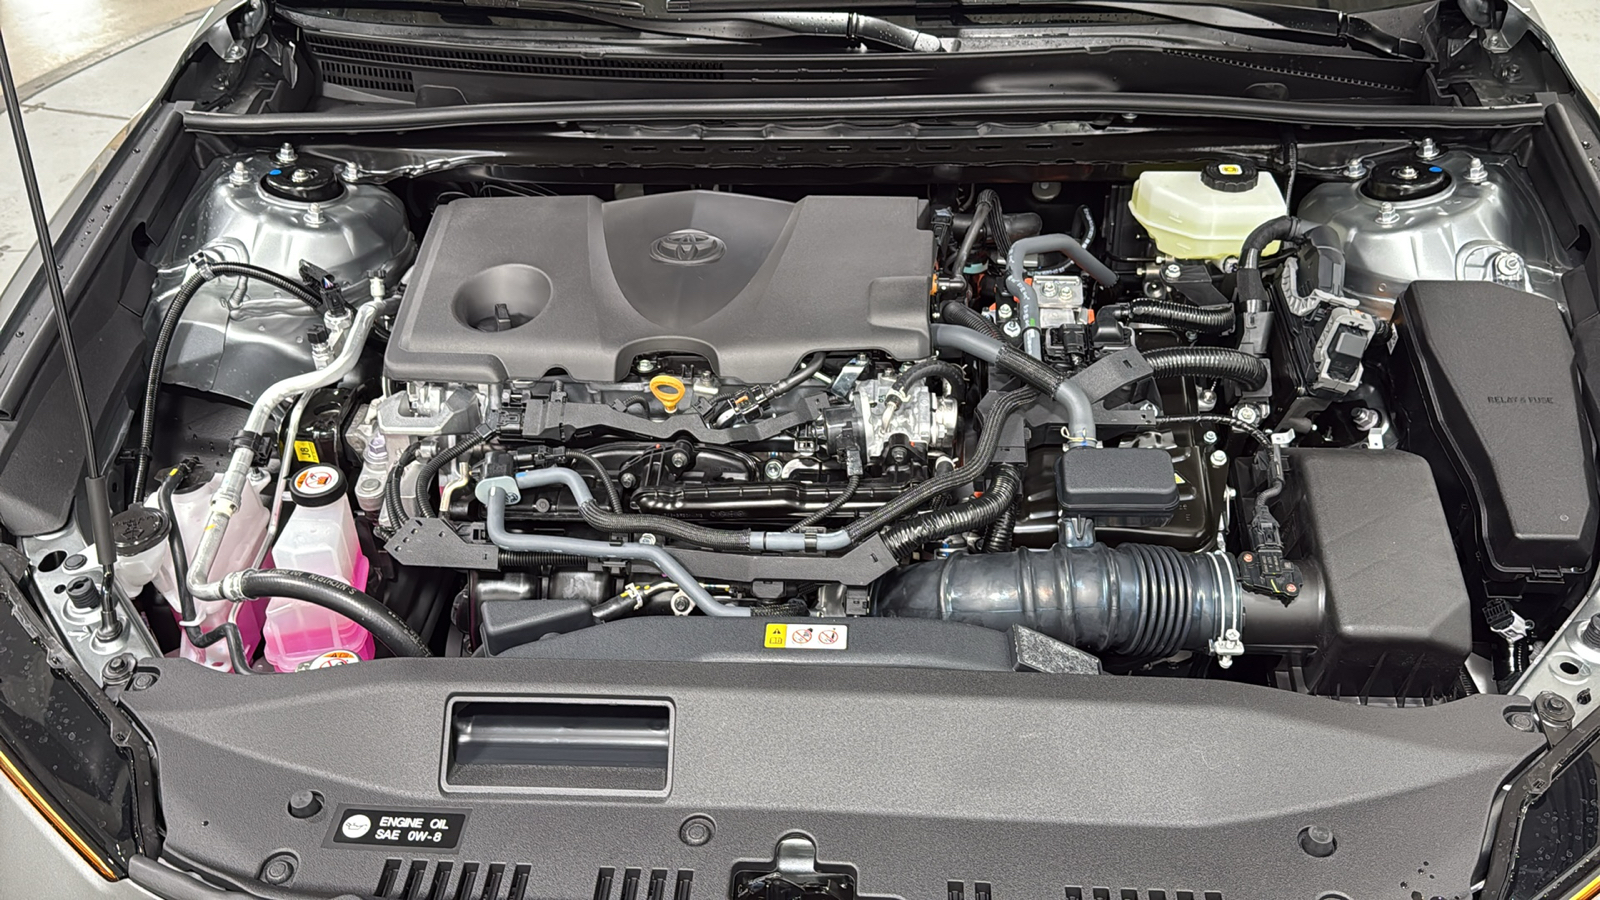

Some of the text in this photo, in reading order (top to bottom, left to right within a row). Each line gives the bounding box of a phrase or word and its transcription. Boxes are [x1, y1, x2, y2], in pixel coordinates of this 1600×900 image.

[1487, 396, 1517, 404] RELAY
[1527, 396, 1554, 404] FUSE
[379, 816, 449, 829] ENGINE OIL
[375, 829, 442, 842] SAE 0W-8
